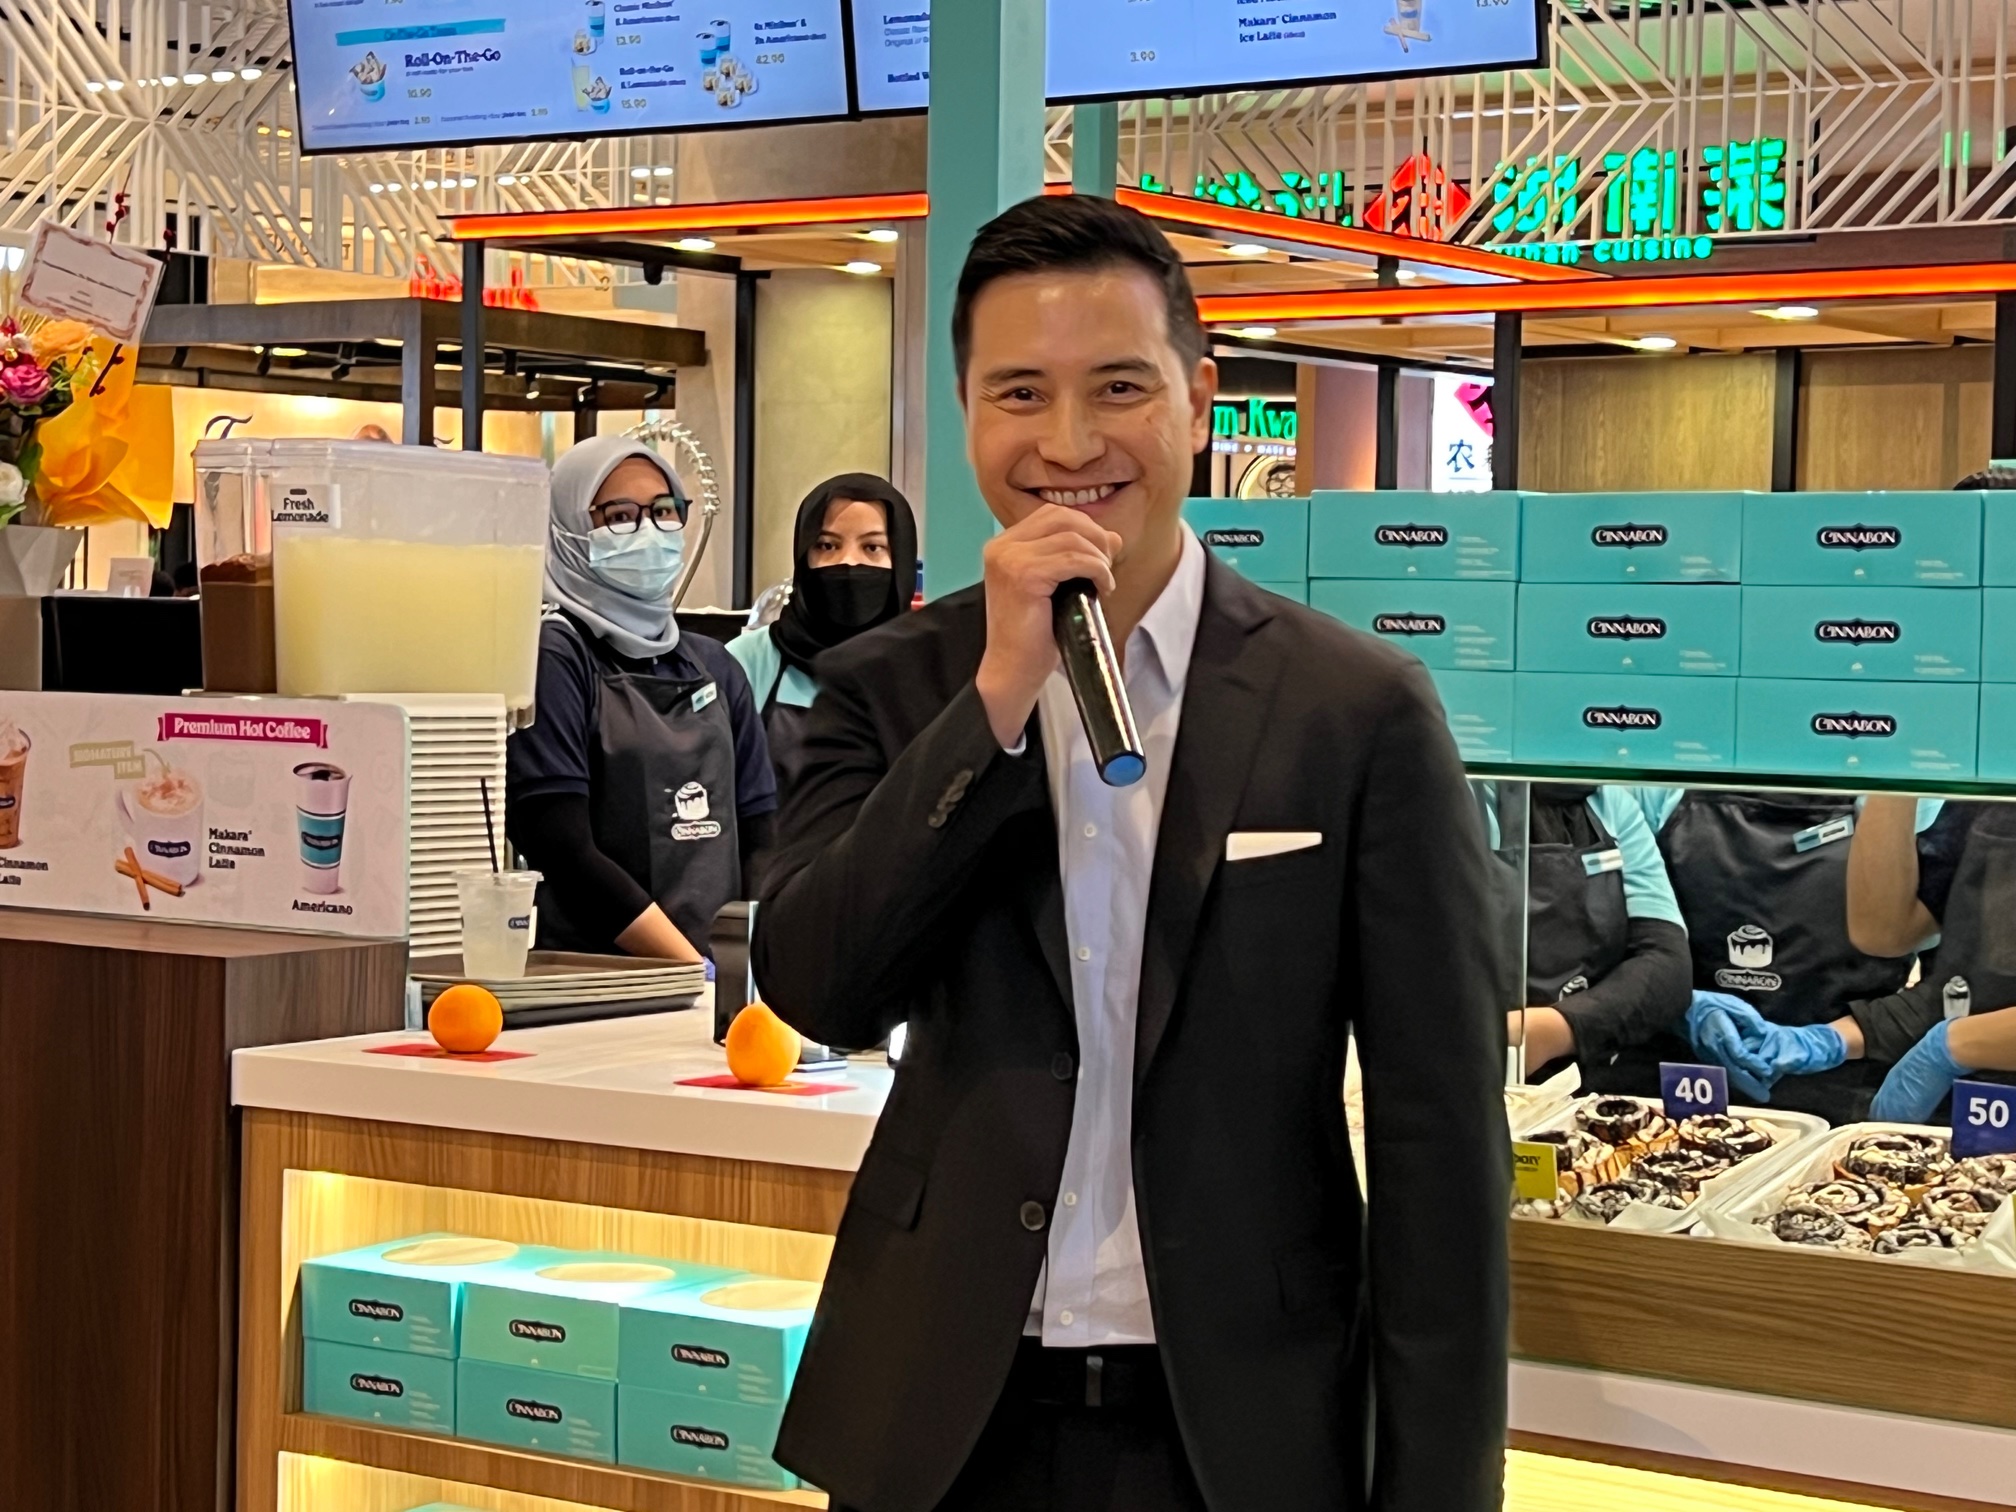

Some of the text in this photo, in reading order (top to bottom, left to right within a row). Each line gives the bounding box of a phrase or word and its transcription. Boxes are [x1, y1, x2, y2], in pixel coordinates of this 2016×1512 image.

[1282, 12, 1337, 23] Cinnamon
[404, 48, 501, 67] Roll-On-The-Go
[283, 497, 315, 510] Fresh
[271, 508, 329, 523] Lemonade
[1378, 529, 1444, 542] CINNABON
[1595, 529, 1663, 543] CINNABON
[1820, 530, 1896, 544] CINNABON
[1376, 616, 1441, 631] CINNABON
[1590, 620, 1661, 635] CINNABON
[1818, 624, 1895, 639] CINNABON
[1586, 710, 1657, 725] CINNABON
[1815, 717, 1891, 732] CINNABON
[174, 717, 311, 740] Premium Hot Coffee
[208, 842, 265, 857] Cinnamon
[208, 857, 236, 869] Latte
[292, 900, 353, 915] Americano
[1675, 1077, 1713, 1104] 40
[1968, 1097, 2010, 1128] 50
